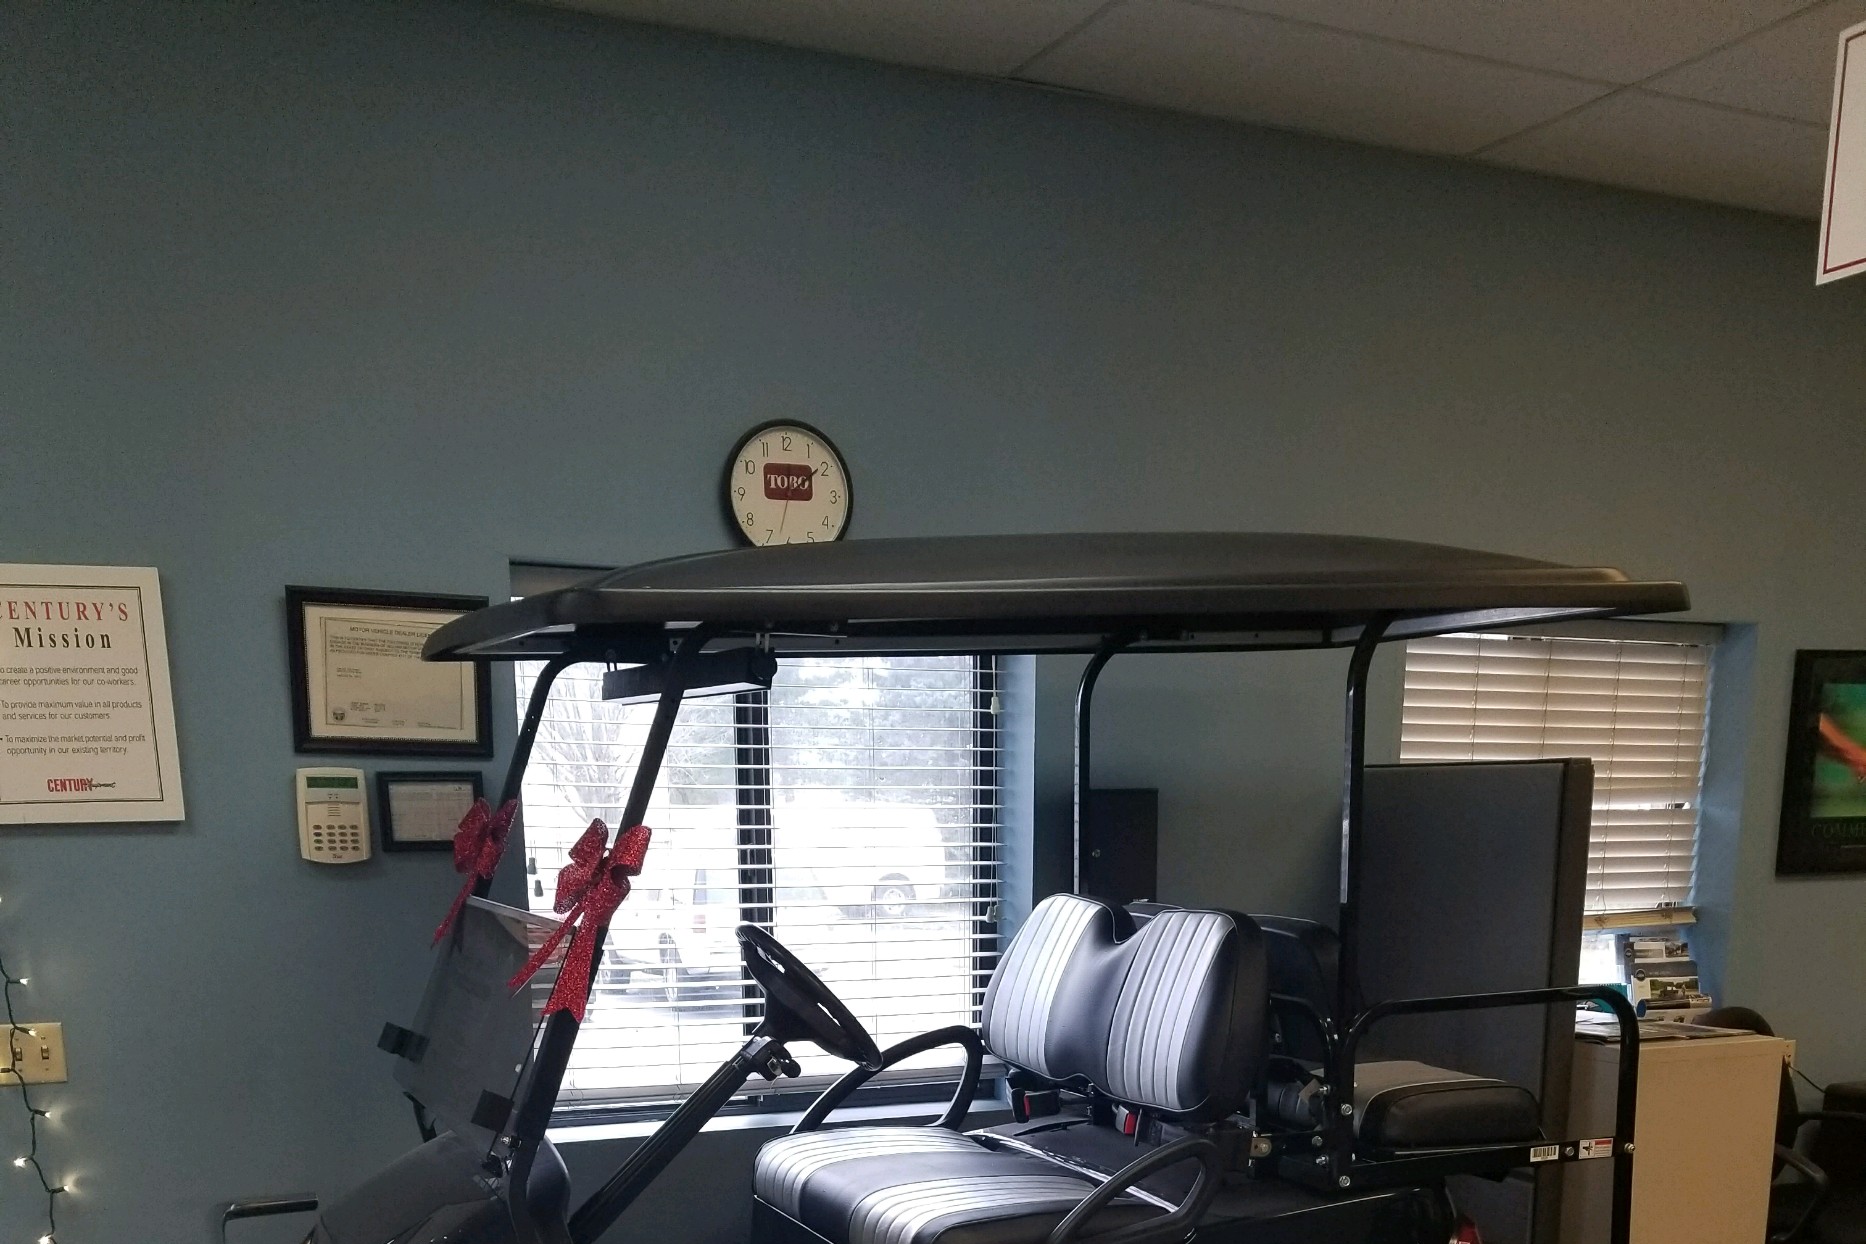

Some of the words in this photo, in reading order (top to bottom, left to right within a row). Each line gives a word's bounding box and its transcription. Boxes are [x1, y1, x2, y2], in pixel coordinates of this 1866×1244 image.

[762, 442, 769, 457] 11
[781, 435, 792, 451] 12
[806, 443, 811, 458] 1
[744, 459, 756, 474] 10
[820, 461, 829, 476] 2
[767, 474, 809, 490] TORO
[737, 486, 746, 501] 9
[829, 490, 838, 504] 3
[746, 512, 754, 526] 8
[821, 515, 829, 530] 4
[765, 529, 773, 543] 7
[0, 600, 128, 621] ENTURY'S
[12, 627, 111, 649] Mission
[6, 667, 28, 675] create
[35, 666, 61, 676] positive
[62, 666, 105, 674] environment
[106, 666, 120, 674] and
[121, 667, 138, 676] good
[23, 677, 69, 687] opportunities
[71, 677, 81, 685] for
[1, 700, 9, 708] To
[10, 701, 37, 710] provide
[102, 700, 111, 708] all
[112, 701, 142, 710] products
[2, 712, 17, 720] and
[48, 712, 58, 720] for
[5, 735, 14, 743] To
[48, 735, 60, 743] the
[60, 735, 85, 743] market
[85, 735, 113, 744] potential
[128, 734, 146, 743] profit
[7, 747, 47, 756] opportunity
[71, 746, 99, 755] existing
[47, 778, 93, 792] CENTURY
